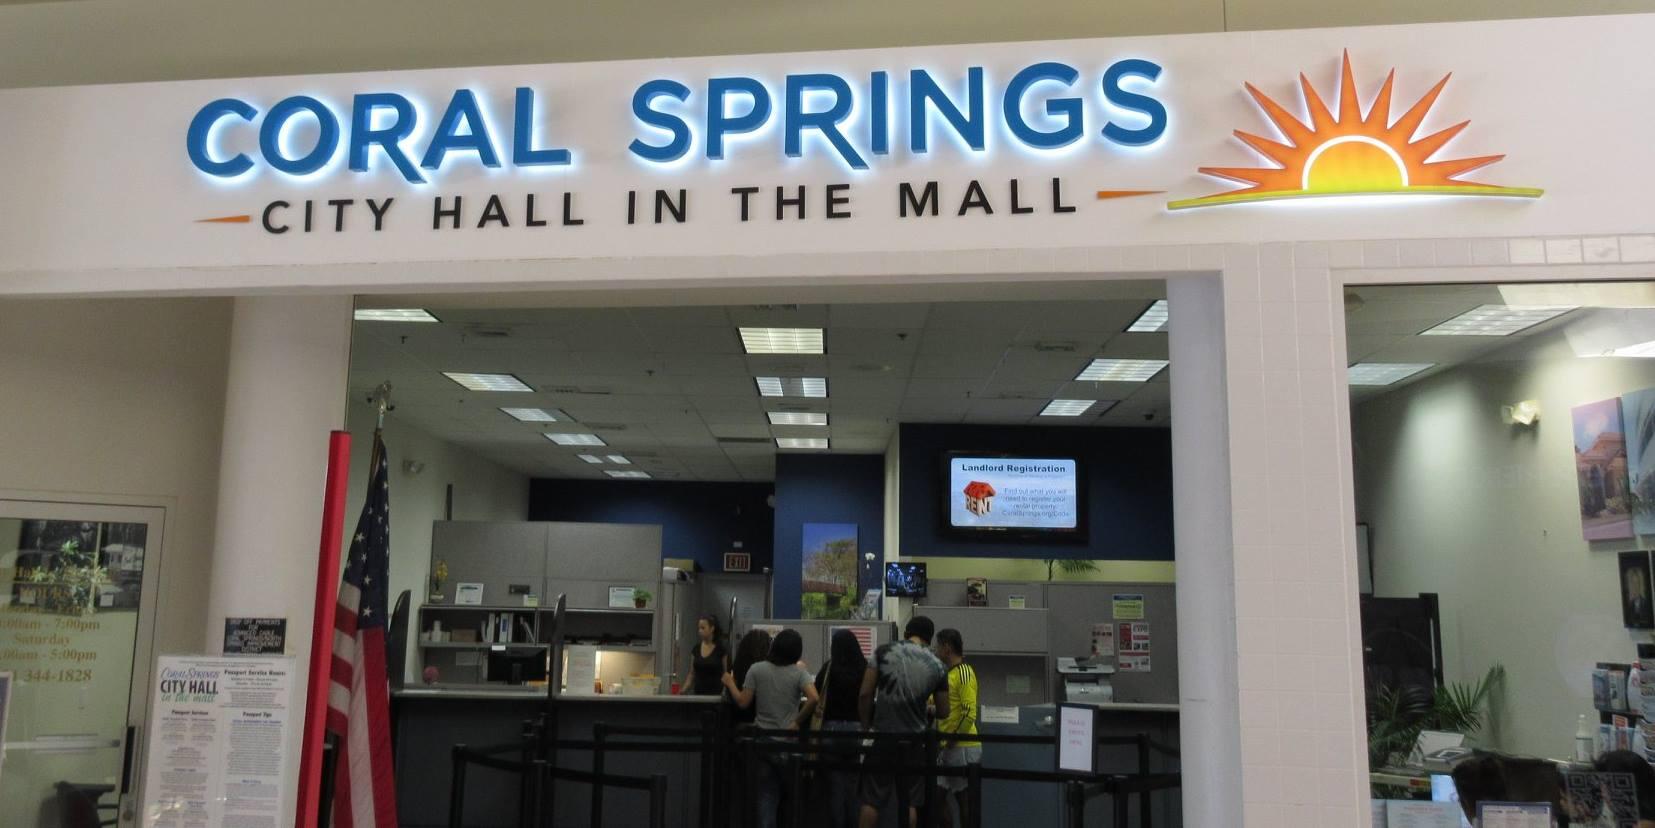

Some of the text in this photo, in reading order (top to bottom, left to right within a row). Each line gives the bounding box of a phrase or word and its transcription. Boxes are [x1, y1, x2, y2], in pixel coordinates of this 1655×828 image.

[187, 58, 1168, 184] CORAL SPRINGS
[262, 176, 1078, 235] CITY HALL IN THE MALL
[962, 463, 1067, 474] Landlord Registration
[964, 494, 993, 517] RENT
[728, 556, 746, 569] EXIT
[54, 617, 100, 633] 7:00pm
[15, 633, 71, 647] Saturday
[48, 647, 97, 663] 5:00pm
[23, 668, 93, 683] 344-1828
[160, 679, 187, 694] CITY
[189, 680, 219, 695] HALL
